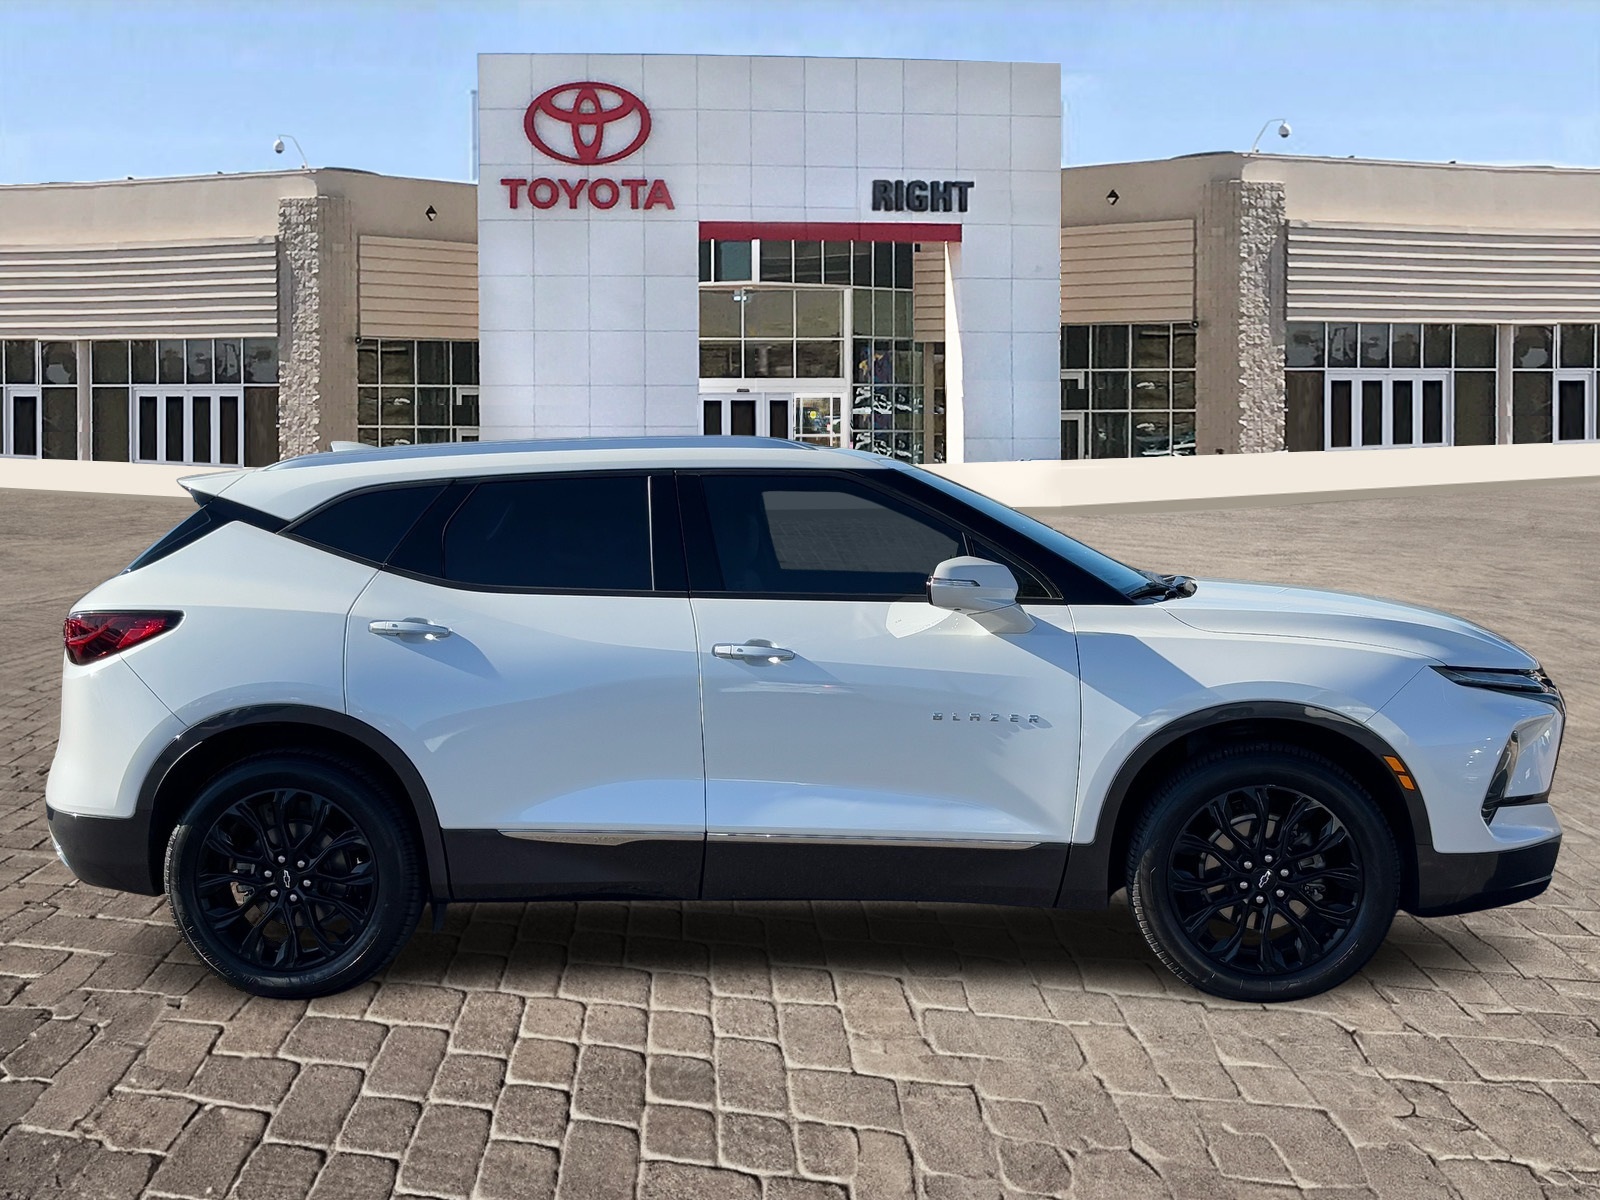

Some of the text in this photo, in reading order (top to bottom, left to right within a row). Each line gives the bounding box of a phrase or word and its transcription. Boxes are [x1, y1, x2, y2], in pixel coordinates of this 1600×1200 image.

[500, 177, 675, 210] TOYOTA
[872, 179, 975, 212] RIGHT
[932, 712, 1040, 723] BLAZER
